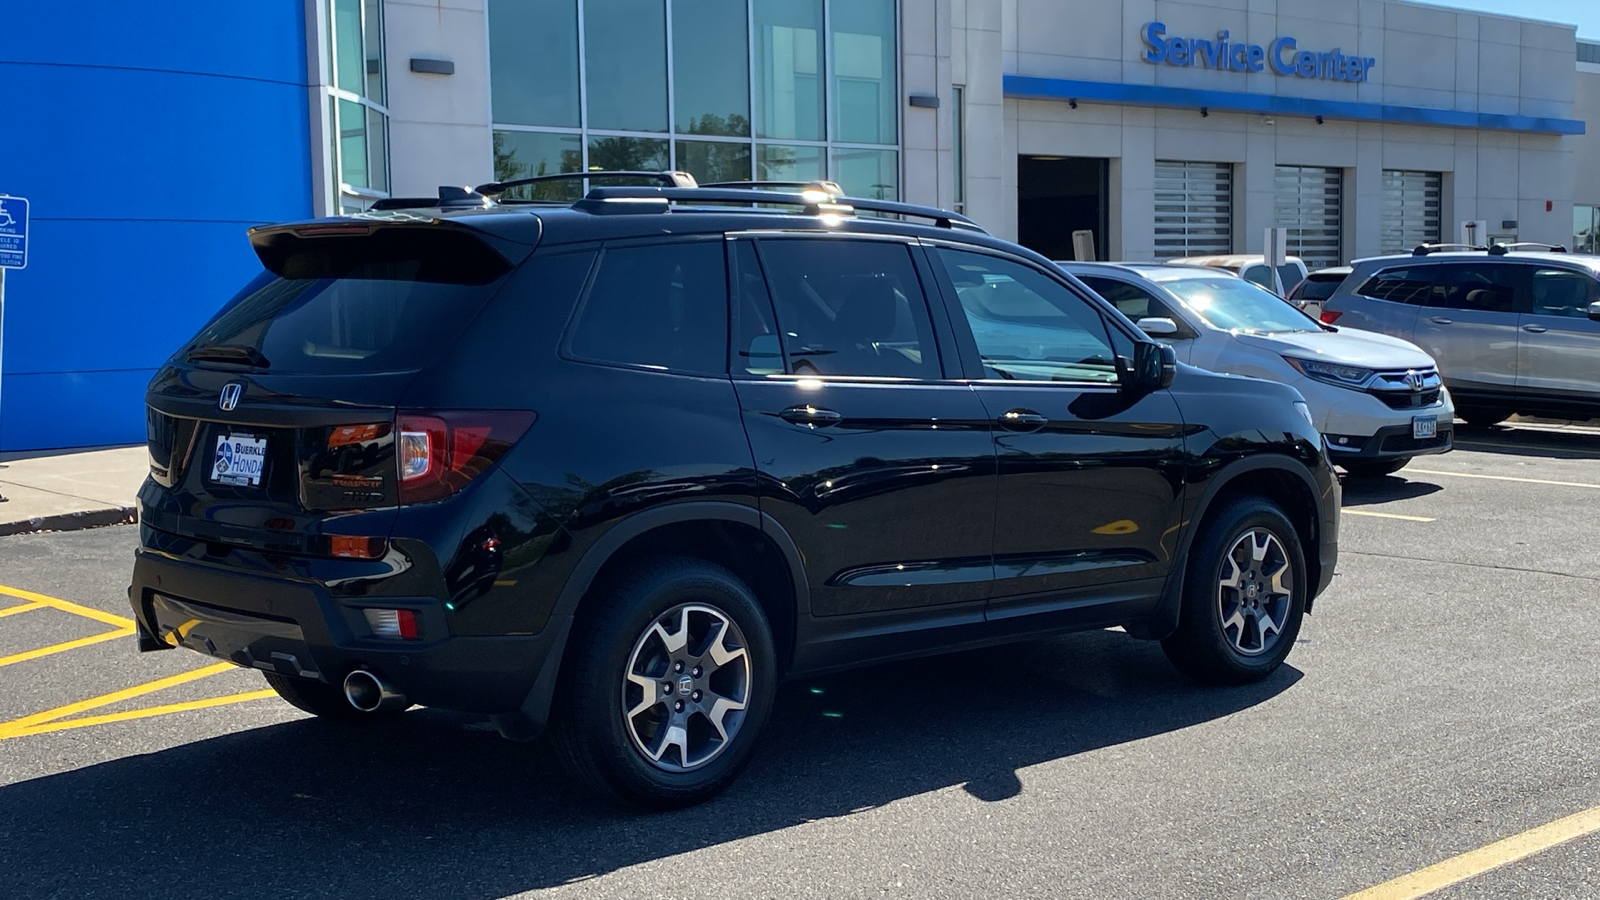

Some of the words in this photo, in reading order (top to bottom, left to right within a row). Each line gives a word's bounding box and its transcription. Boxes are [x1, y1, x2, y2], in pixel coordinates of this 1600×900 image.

[1142, 22, 1264, 72] Service
[1269, 36, 1375, 82] Center
[235, 443, 266, 456] BUERKLE
[231, 455, 263, 474] HONDA
